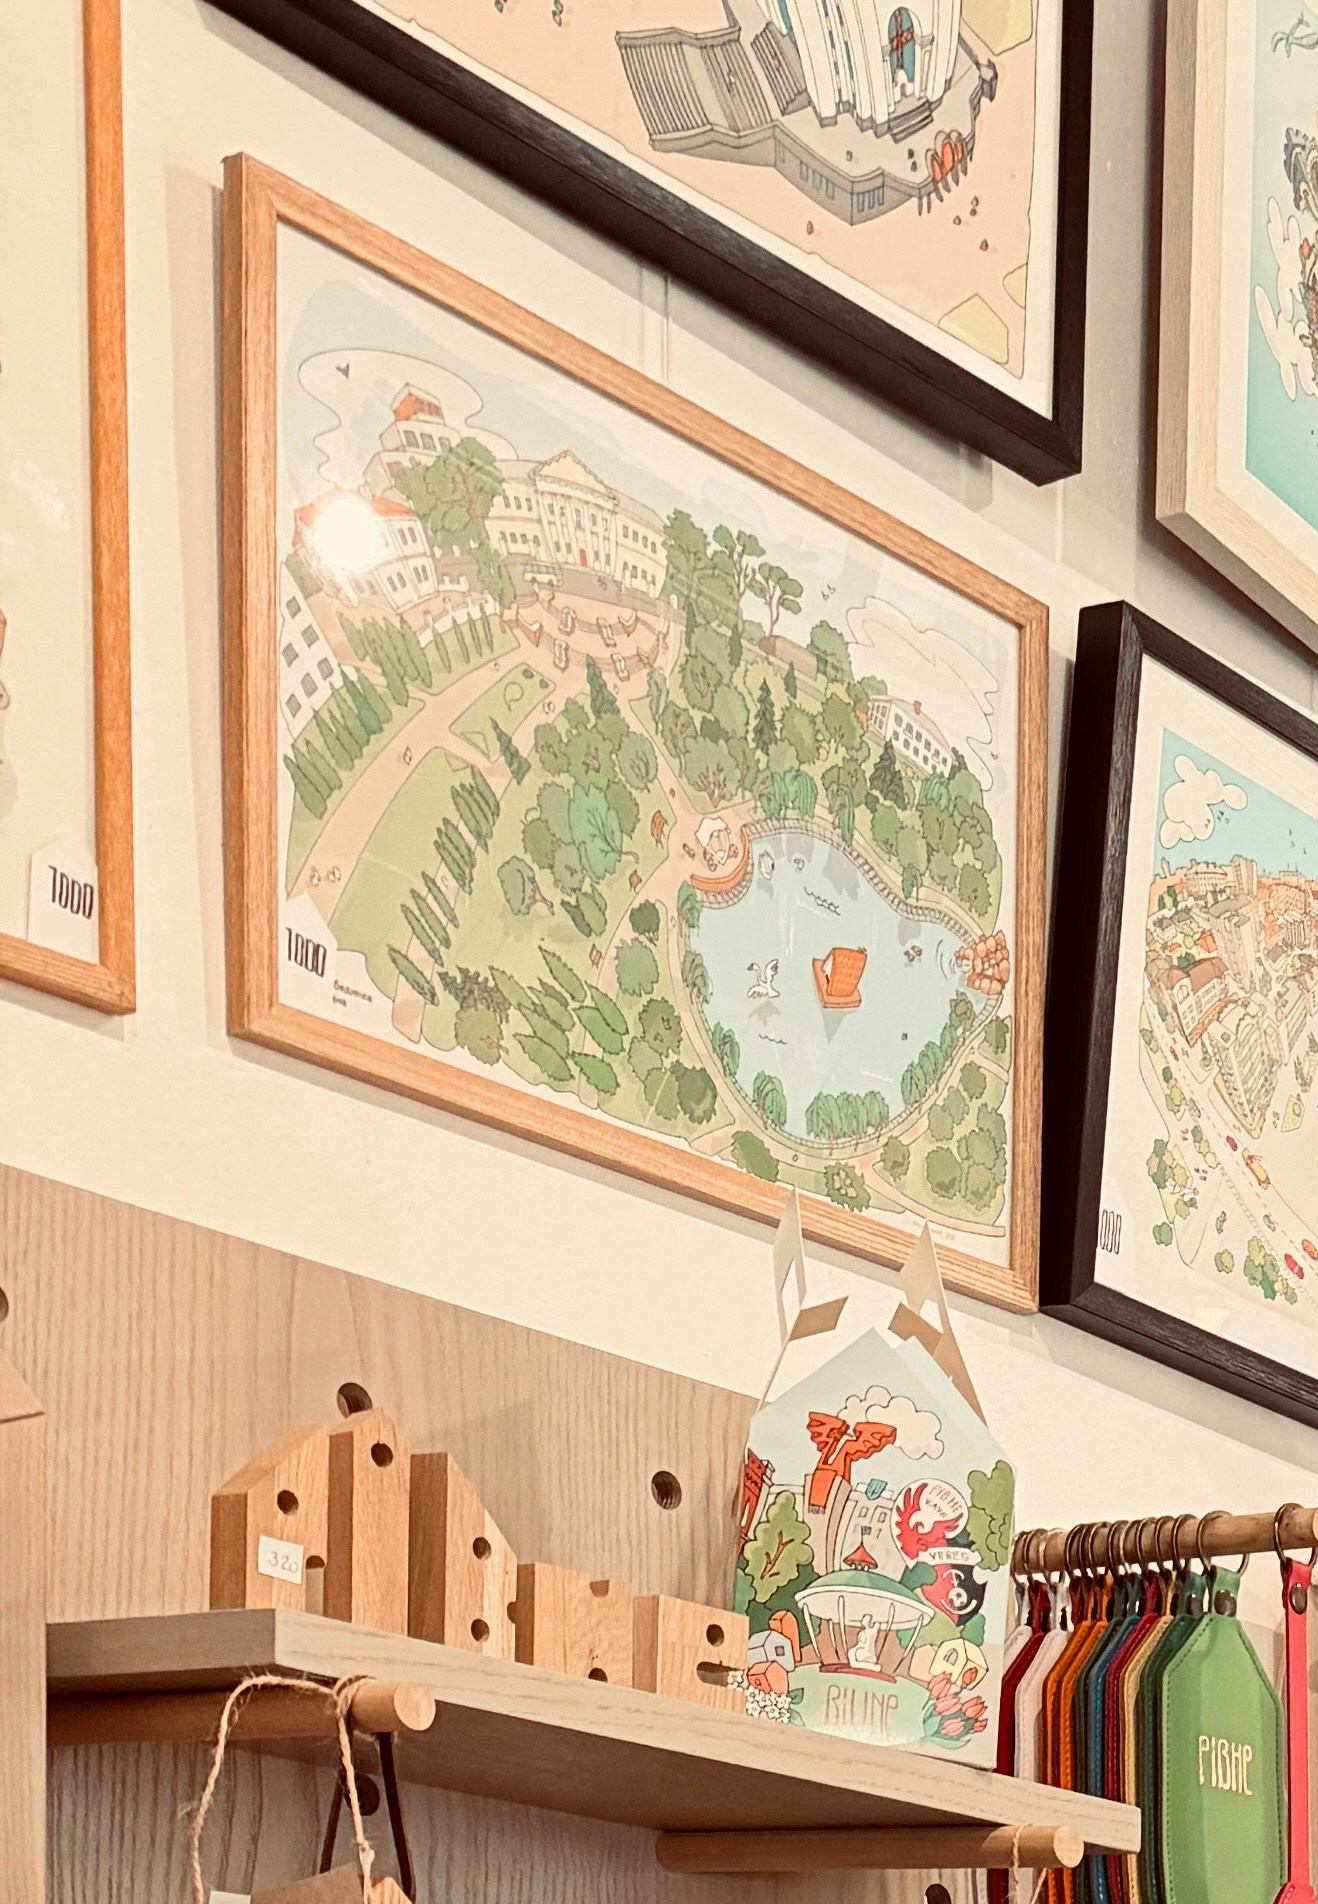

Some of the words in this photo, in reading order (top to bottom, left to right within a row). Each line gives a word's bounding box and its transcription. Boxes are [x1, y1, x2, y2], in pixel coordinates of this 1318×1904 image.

[48, 864, 95, 920] 1000
[285, 926, 327, 978] 1000
[269, 1551, 299, 1574] 320
[1198, 1735, 1253, 1795] РІВНЕ
